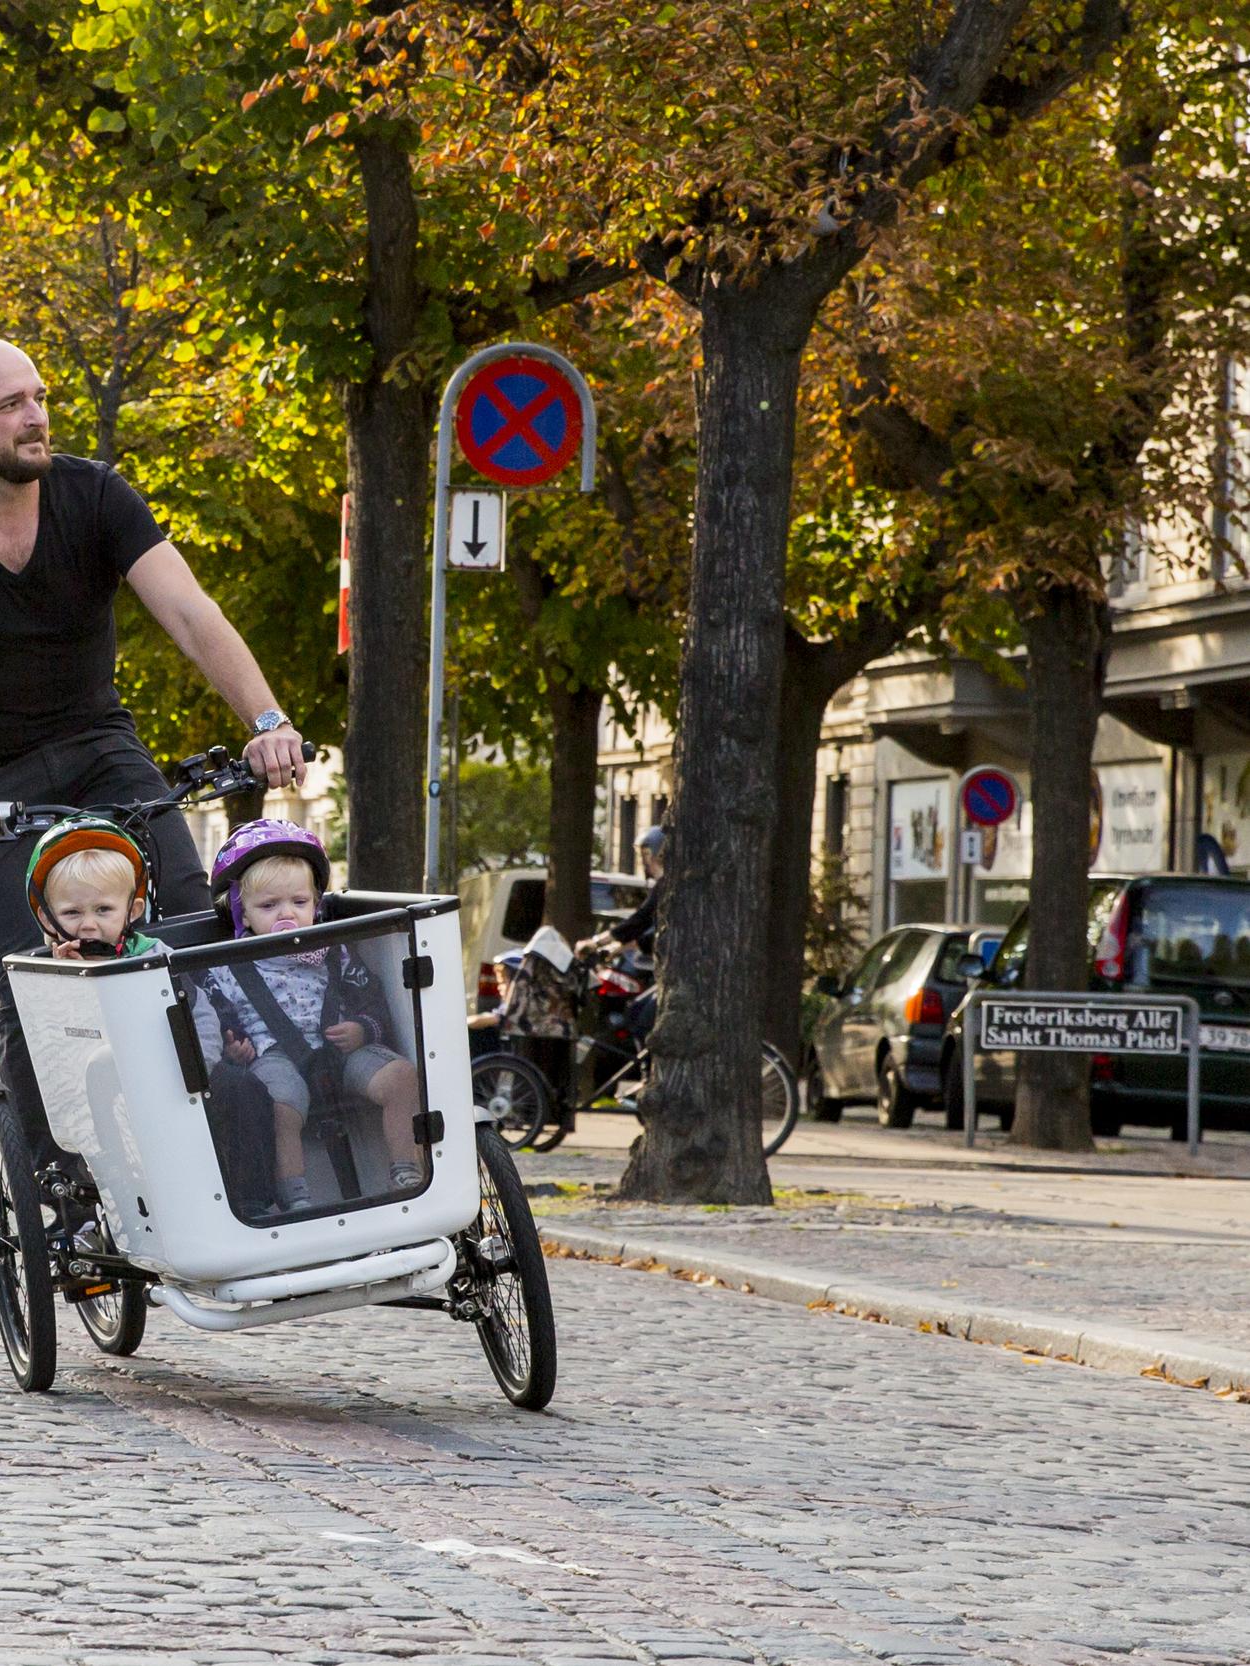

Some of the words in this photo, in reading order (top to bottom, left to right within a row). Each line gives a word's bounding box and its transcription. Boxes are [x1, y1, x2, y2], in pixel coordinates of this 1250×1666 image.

[992, 1006, 1129, 1031] Frederiksberg
[987, 1026, 1041, 1045] Sankt
[1044, 1028, 1120, 1047] Thomas
[1126, 1030, 1175, 1048] Plads
